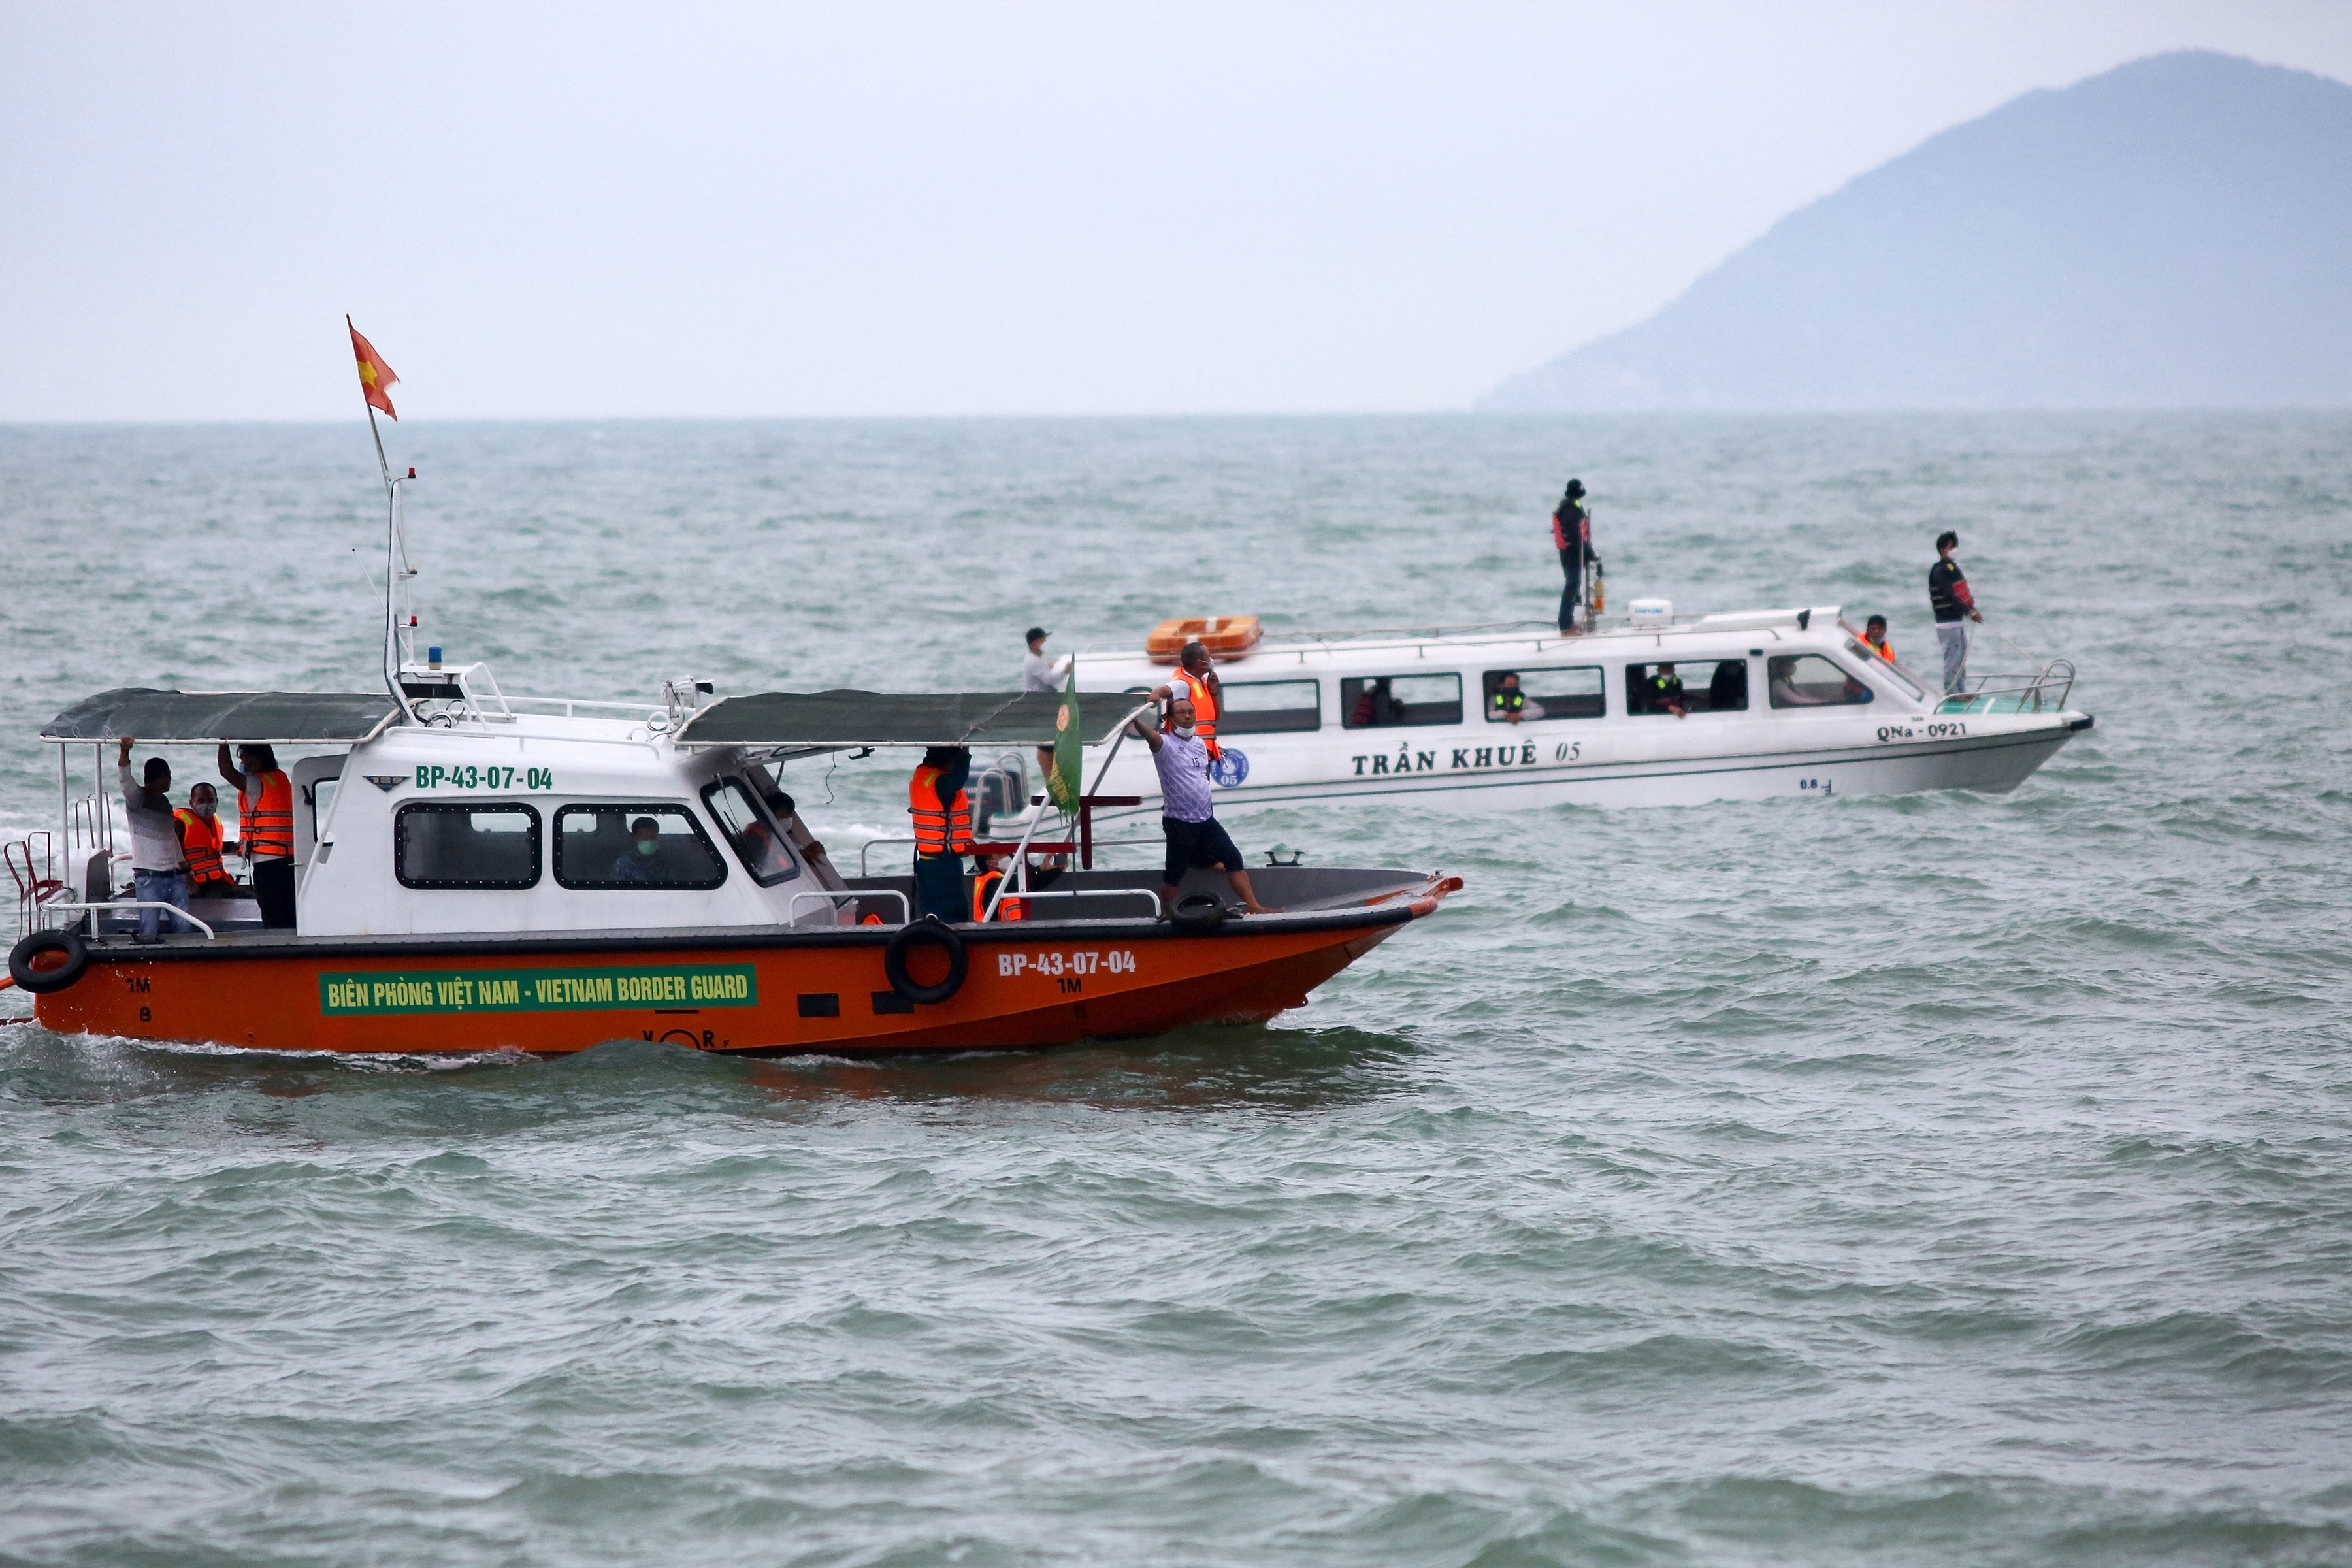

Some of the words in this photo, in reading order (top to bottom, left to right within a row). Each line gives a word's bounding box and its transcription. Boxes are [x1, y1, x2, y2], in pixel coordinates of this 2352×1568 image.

[1877, 726, 1913, 742] QNa
[1928, 723, 1966, 737] 0921
[1192, 757, 1200, 768] 15
[1352, 742, 1437, 775] TRẦN
[1451, 738, 1537, 769] KHUÊ
[1556, 742, 1582, 761] 05
[416, 766, 553, 790] BP-43-07-04
[1220, 775, 1237, 785] 05
[1800, 779, 1818, 789] 0.8
[998, 951, 1136, 976] BP-43-07-04
[125, 977, 151, 993] 1M
[328, 978, 369, 1007] BIÊN
[374, 976, 433, 1007] PHÒNG
[437, 976, 473, 1010] VIỆT
[478, 980, 519, 1005] NAM
[535, 978, 613, 1003] VIETNAM
[617, 977, 687, 1002] BORDER
[691, 975, 748, 999] GUARD
[1057, 977, 1082, 993] 1M
[139, 1006, 152, 1022] 8
[702, 1030, 715, 1047] R
